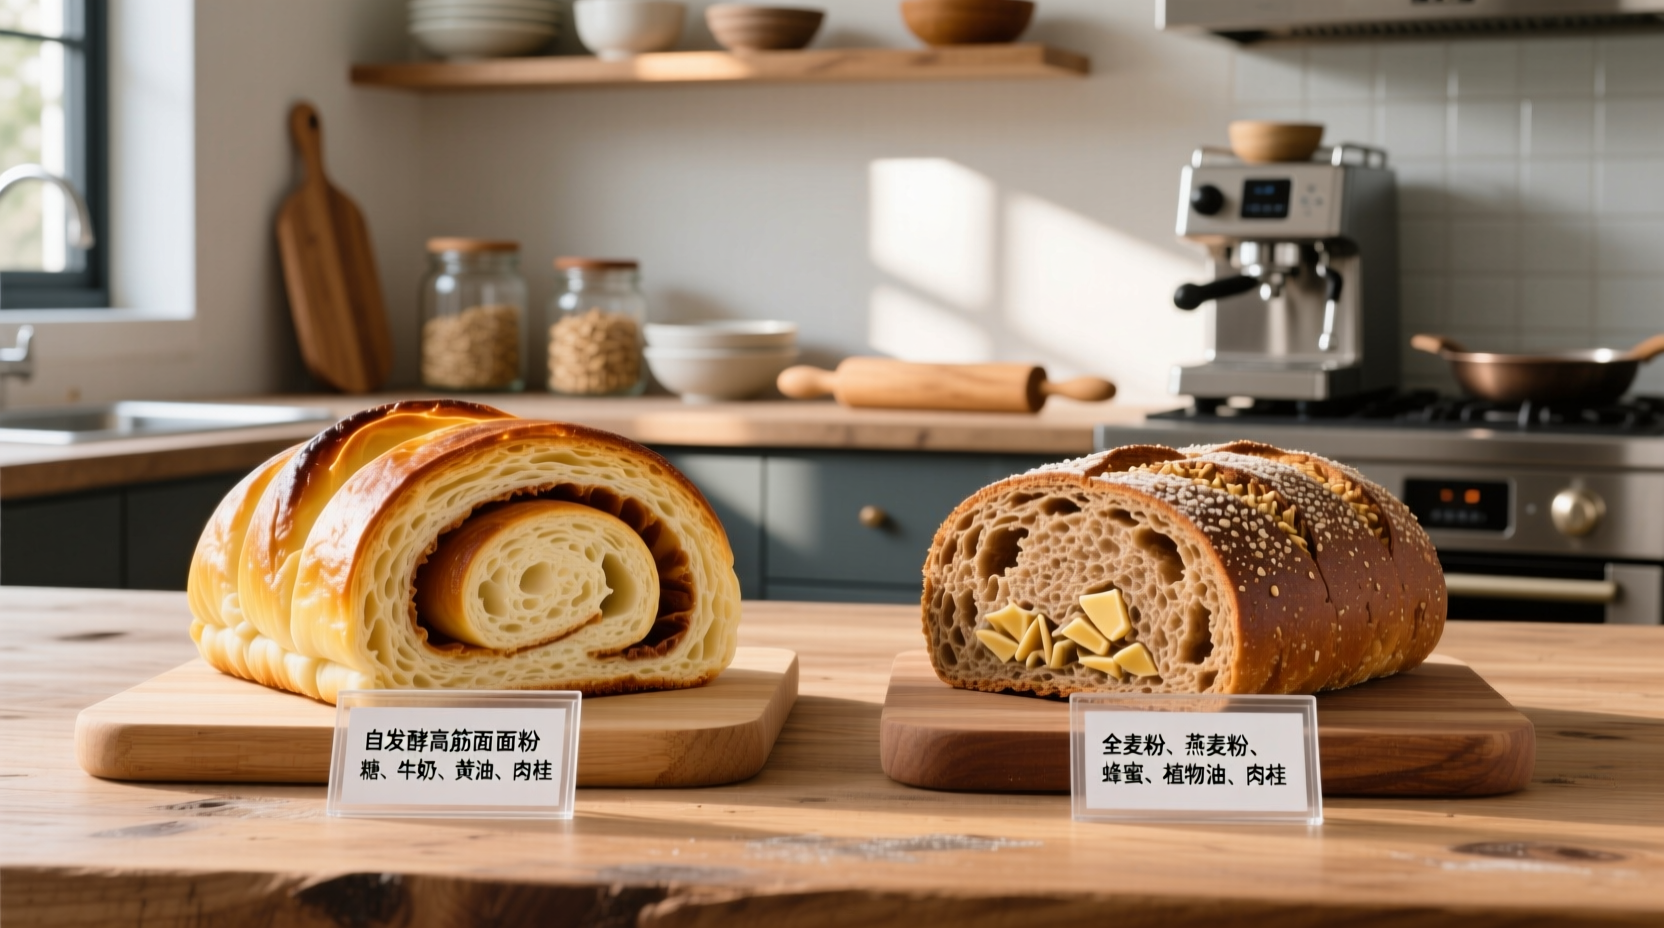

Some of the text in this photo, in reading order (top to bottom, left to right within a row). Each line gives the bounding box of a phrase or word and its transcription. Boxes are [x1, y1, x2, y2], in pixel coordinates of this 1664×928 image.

[365, 728, 541, 752] 自发酵高筋面面粉
[1102, 732, 1257, 757] 全麦粉、燕麦粉、
[360, 758, 553, 781] 糖、牛奶、黄油、肉桂
[1102, 761, 1287, 786] 蜂蜜、植物油、肉桂
